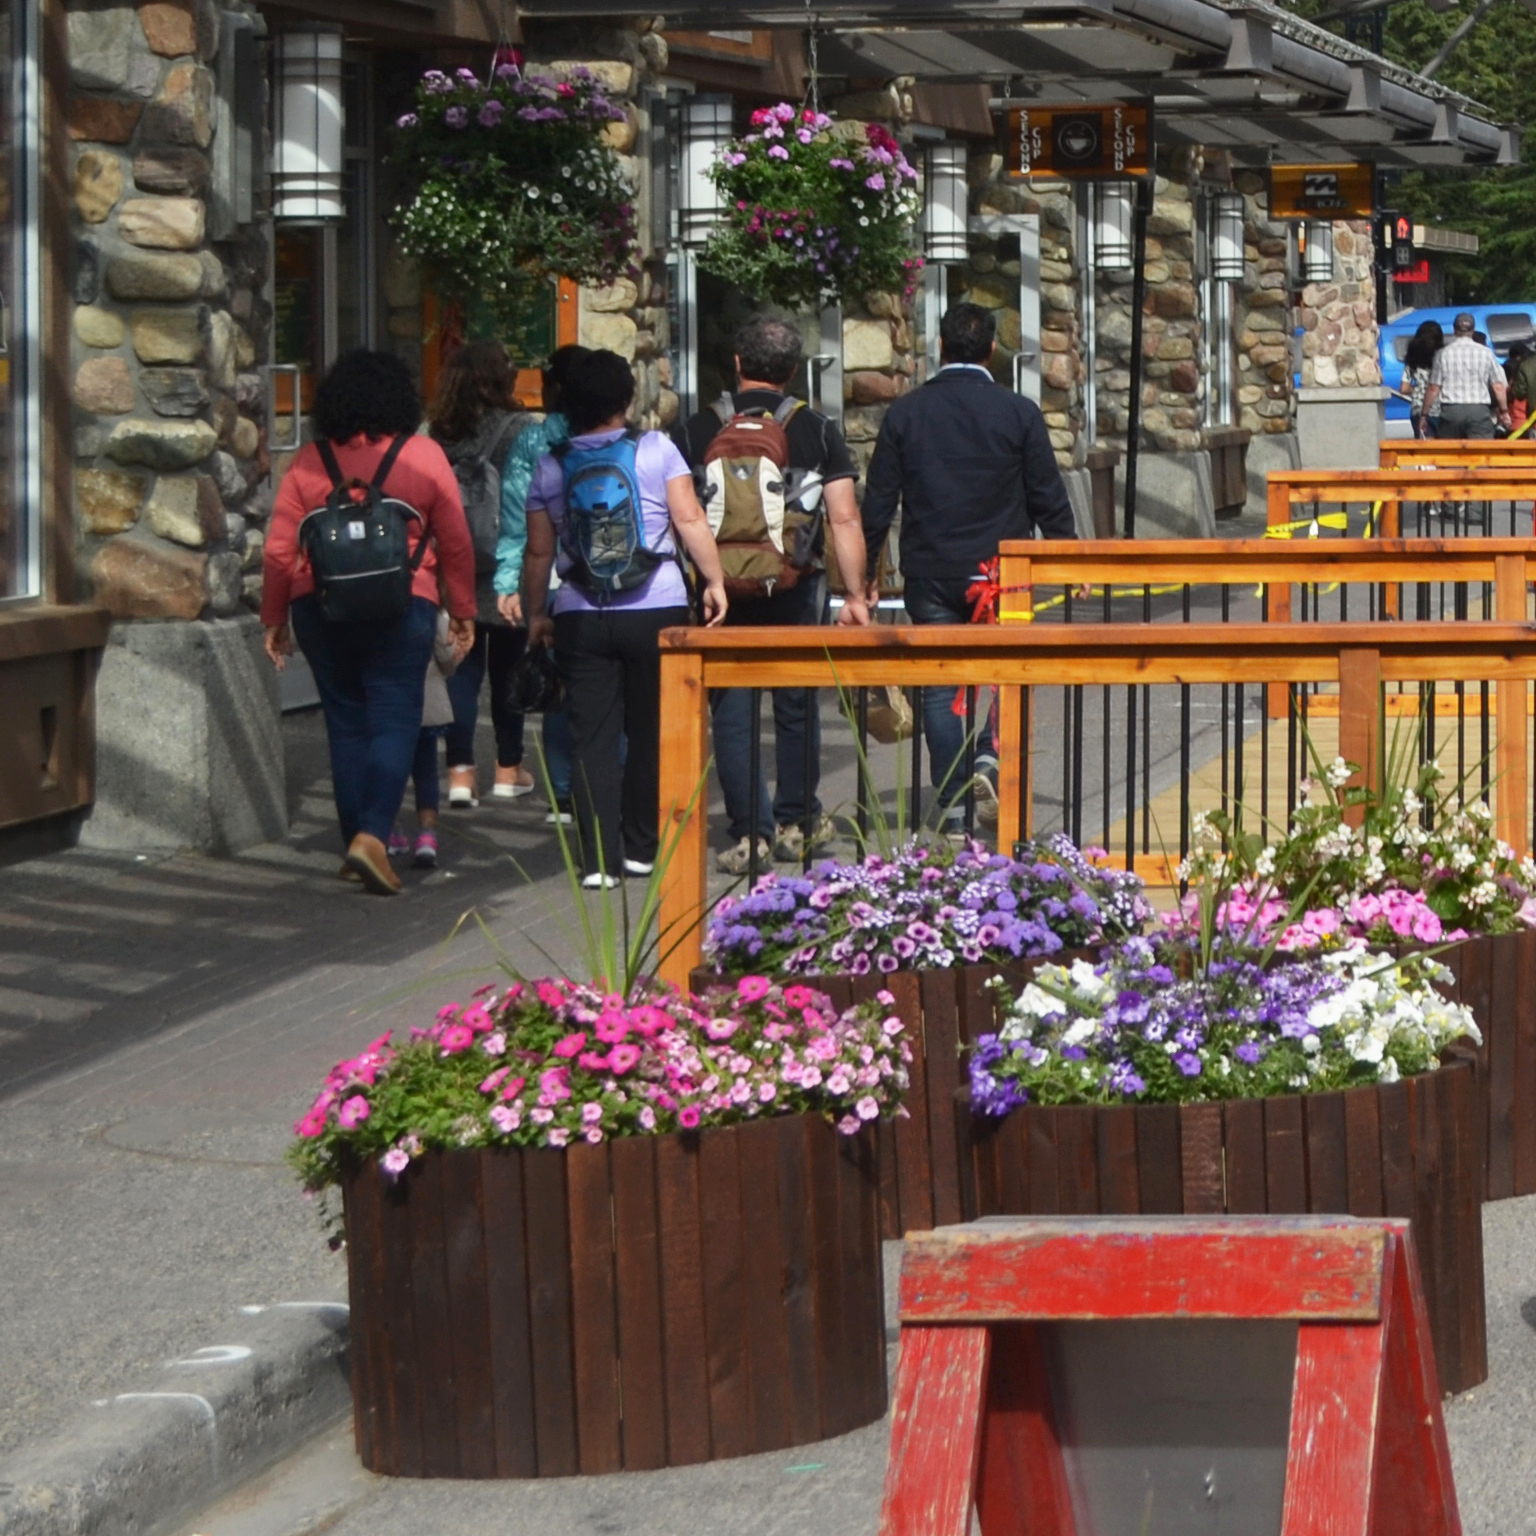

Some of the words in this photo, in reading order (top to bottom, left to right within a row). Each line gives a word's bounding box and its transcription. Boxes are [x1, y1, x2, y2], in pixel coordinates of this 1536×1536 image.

[1020, 110, 1031, 174] SECOND
[1032, 127, 1042, 160] CUP
[1113, 107, 1125, 172] SECOND
[1125, 124, 1136, 157] CUP
